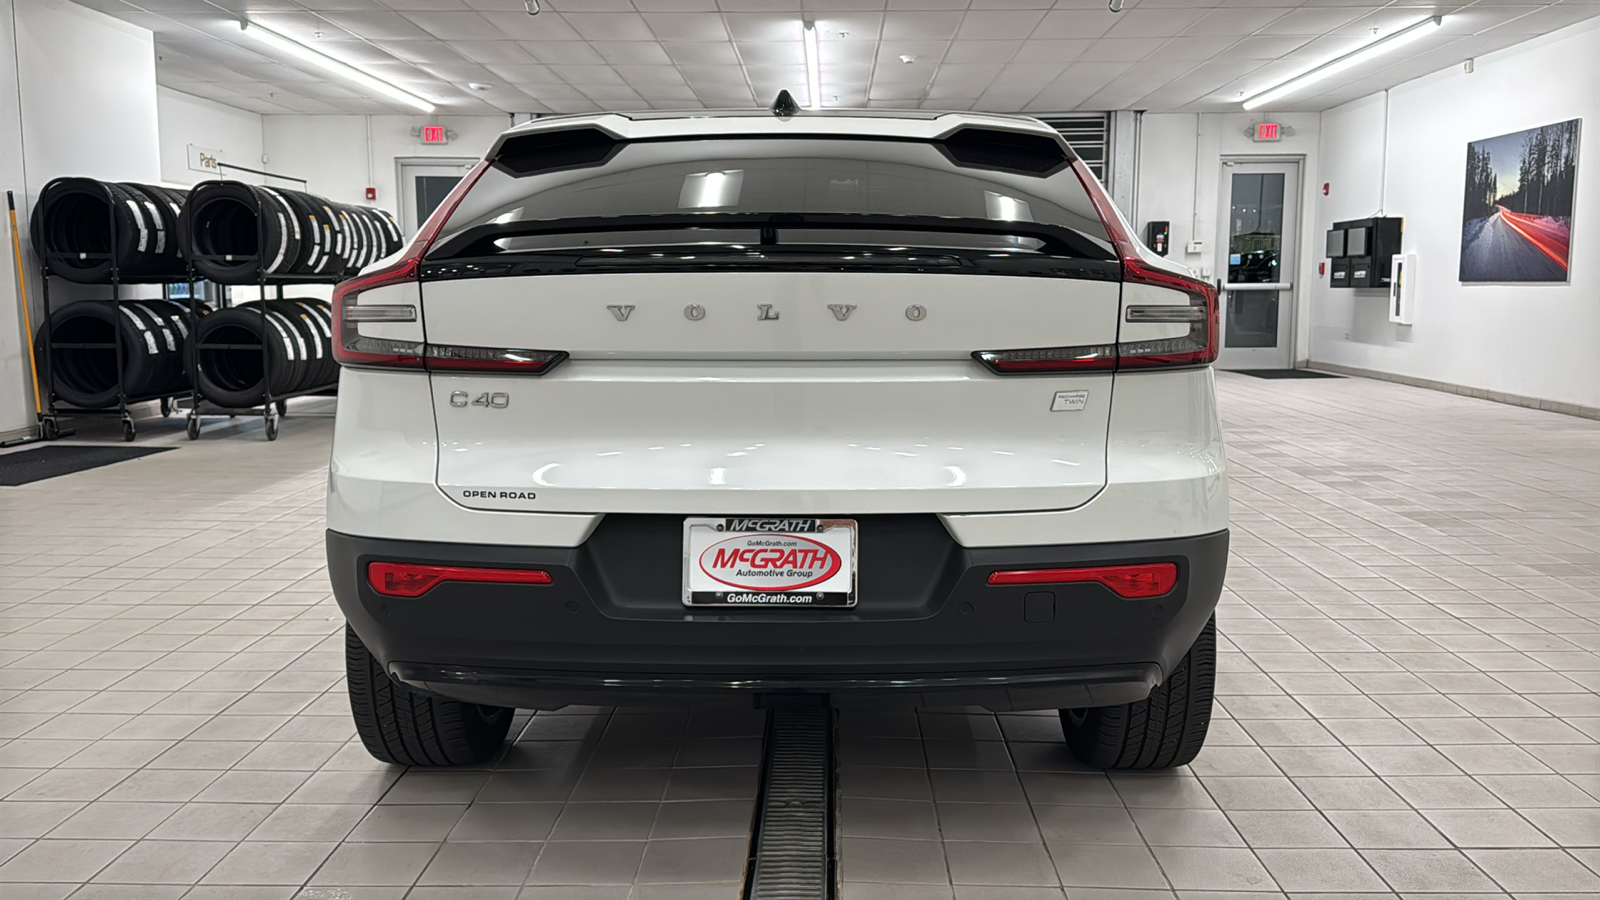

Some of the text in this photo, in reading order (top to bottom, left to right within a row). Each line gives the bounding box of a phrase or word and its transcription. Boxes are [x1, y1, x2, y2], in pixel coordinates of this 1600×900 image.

[424, 126, 443, 141] EXIT
[1259, 123, 1278, 138] EXIT
[199, 152, 217, 169] Parts
[606, 303, 927, 322] VOLVO
[449, 390, 510, 409] C40
[463, 490, 536, 500] OPEN ROAD
[735, 569, 813, 579] Automotive Group
[727, 593, 812, 603] GoMcGrath.com
